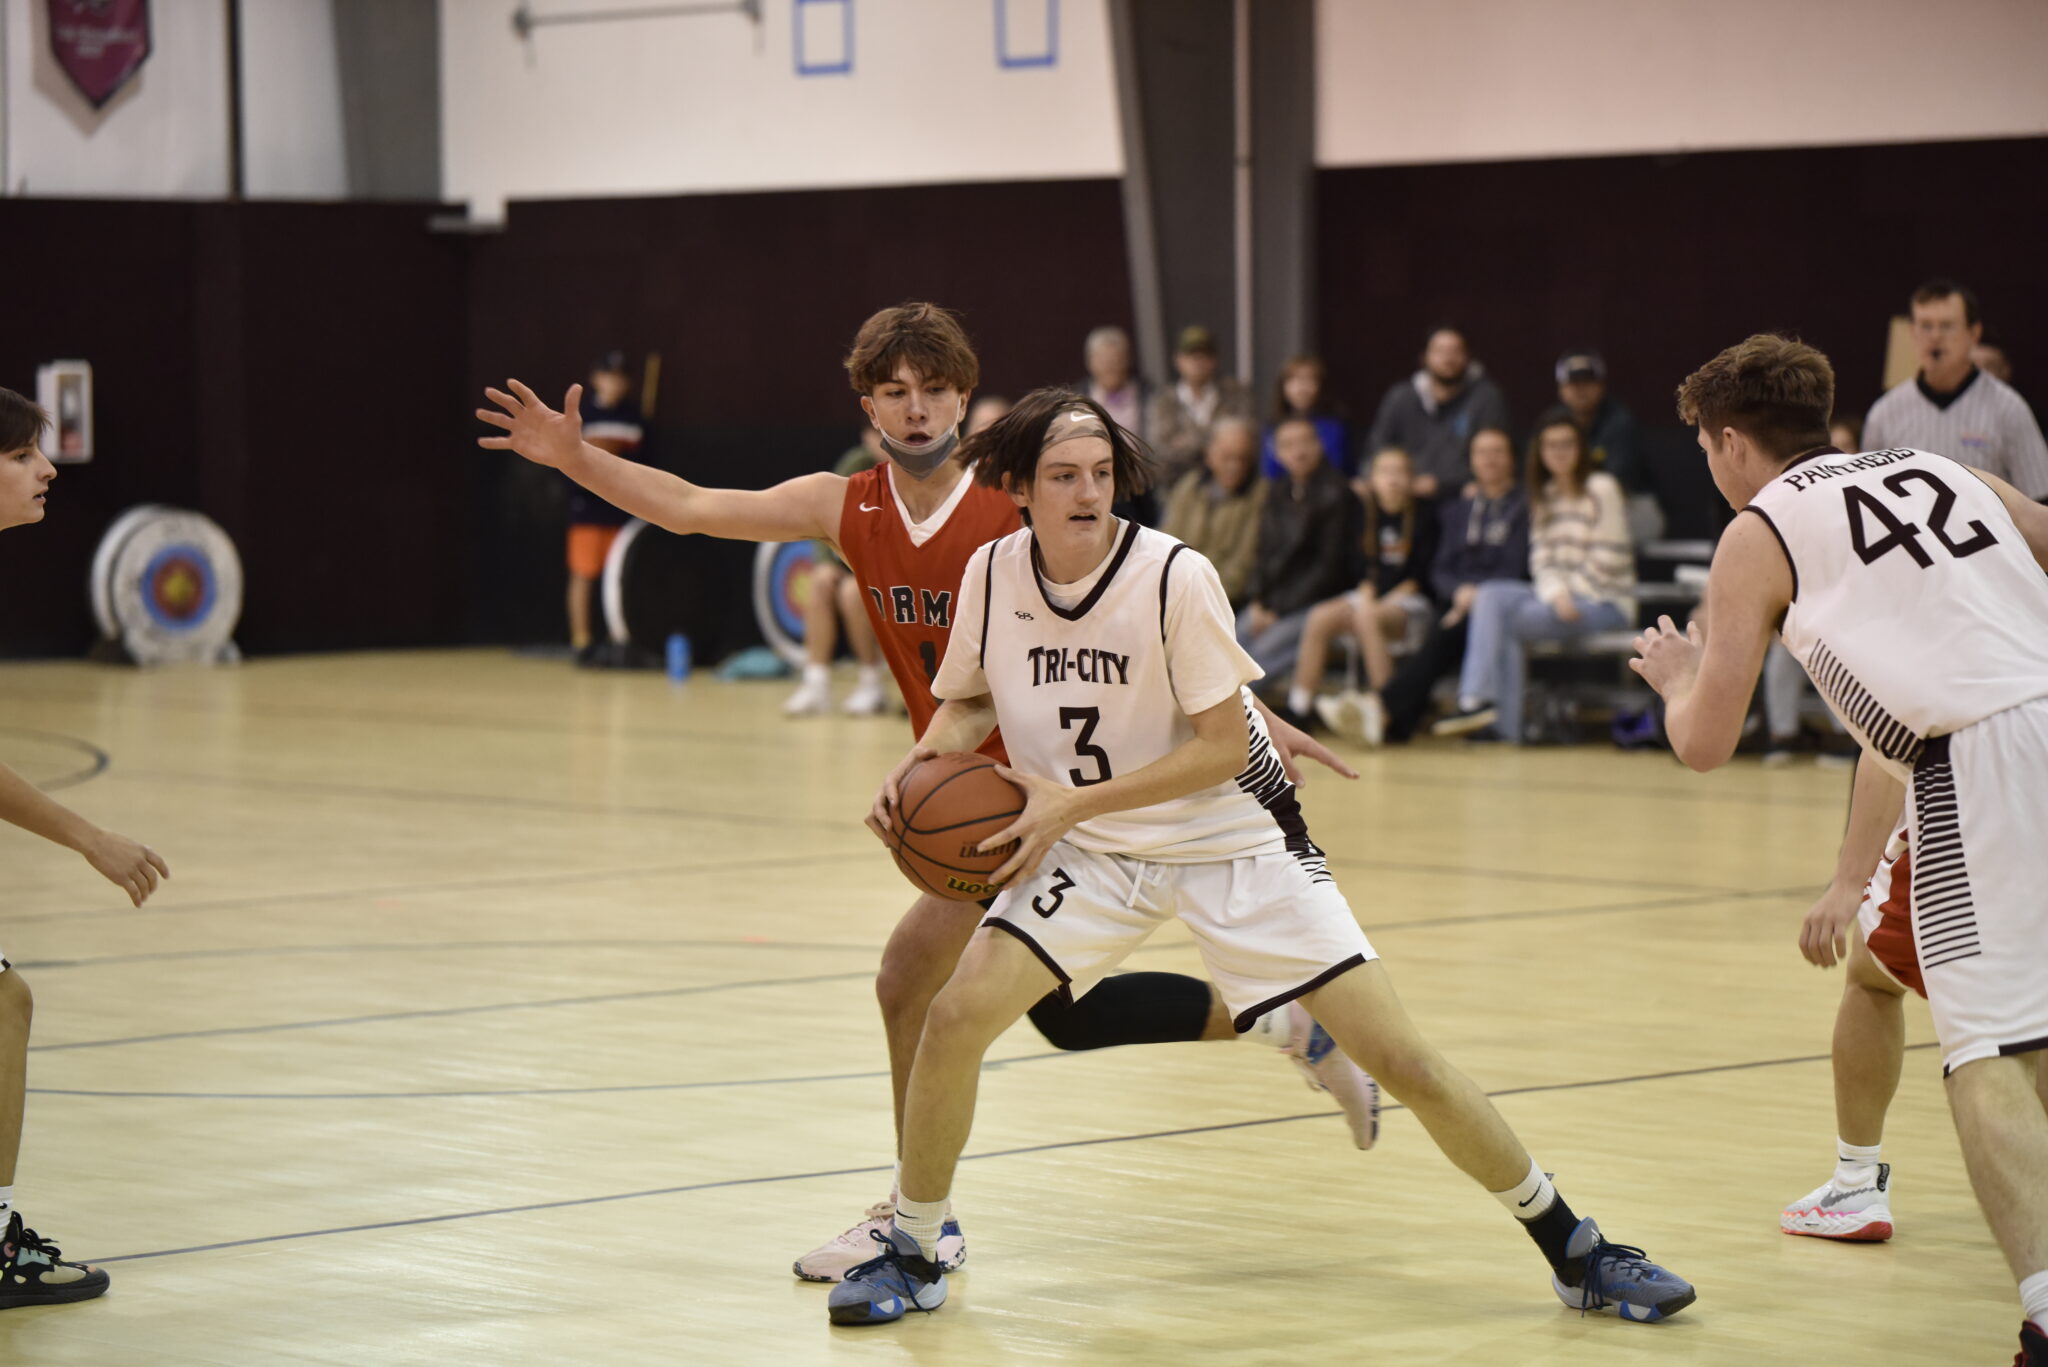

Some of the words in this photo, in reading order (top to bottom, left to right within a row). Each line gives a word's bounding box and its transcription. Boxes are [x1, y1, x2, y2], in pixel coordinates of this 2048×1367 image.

[1783, 448, 1916, 492] PANTHERS
[1842, 468, 2000, 570] 42
[1027, 645, 1130, 688] TRI-CITY
[1059, 706, 1113, 788] 3
[1031, 867, 1077, 919] 3
